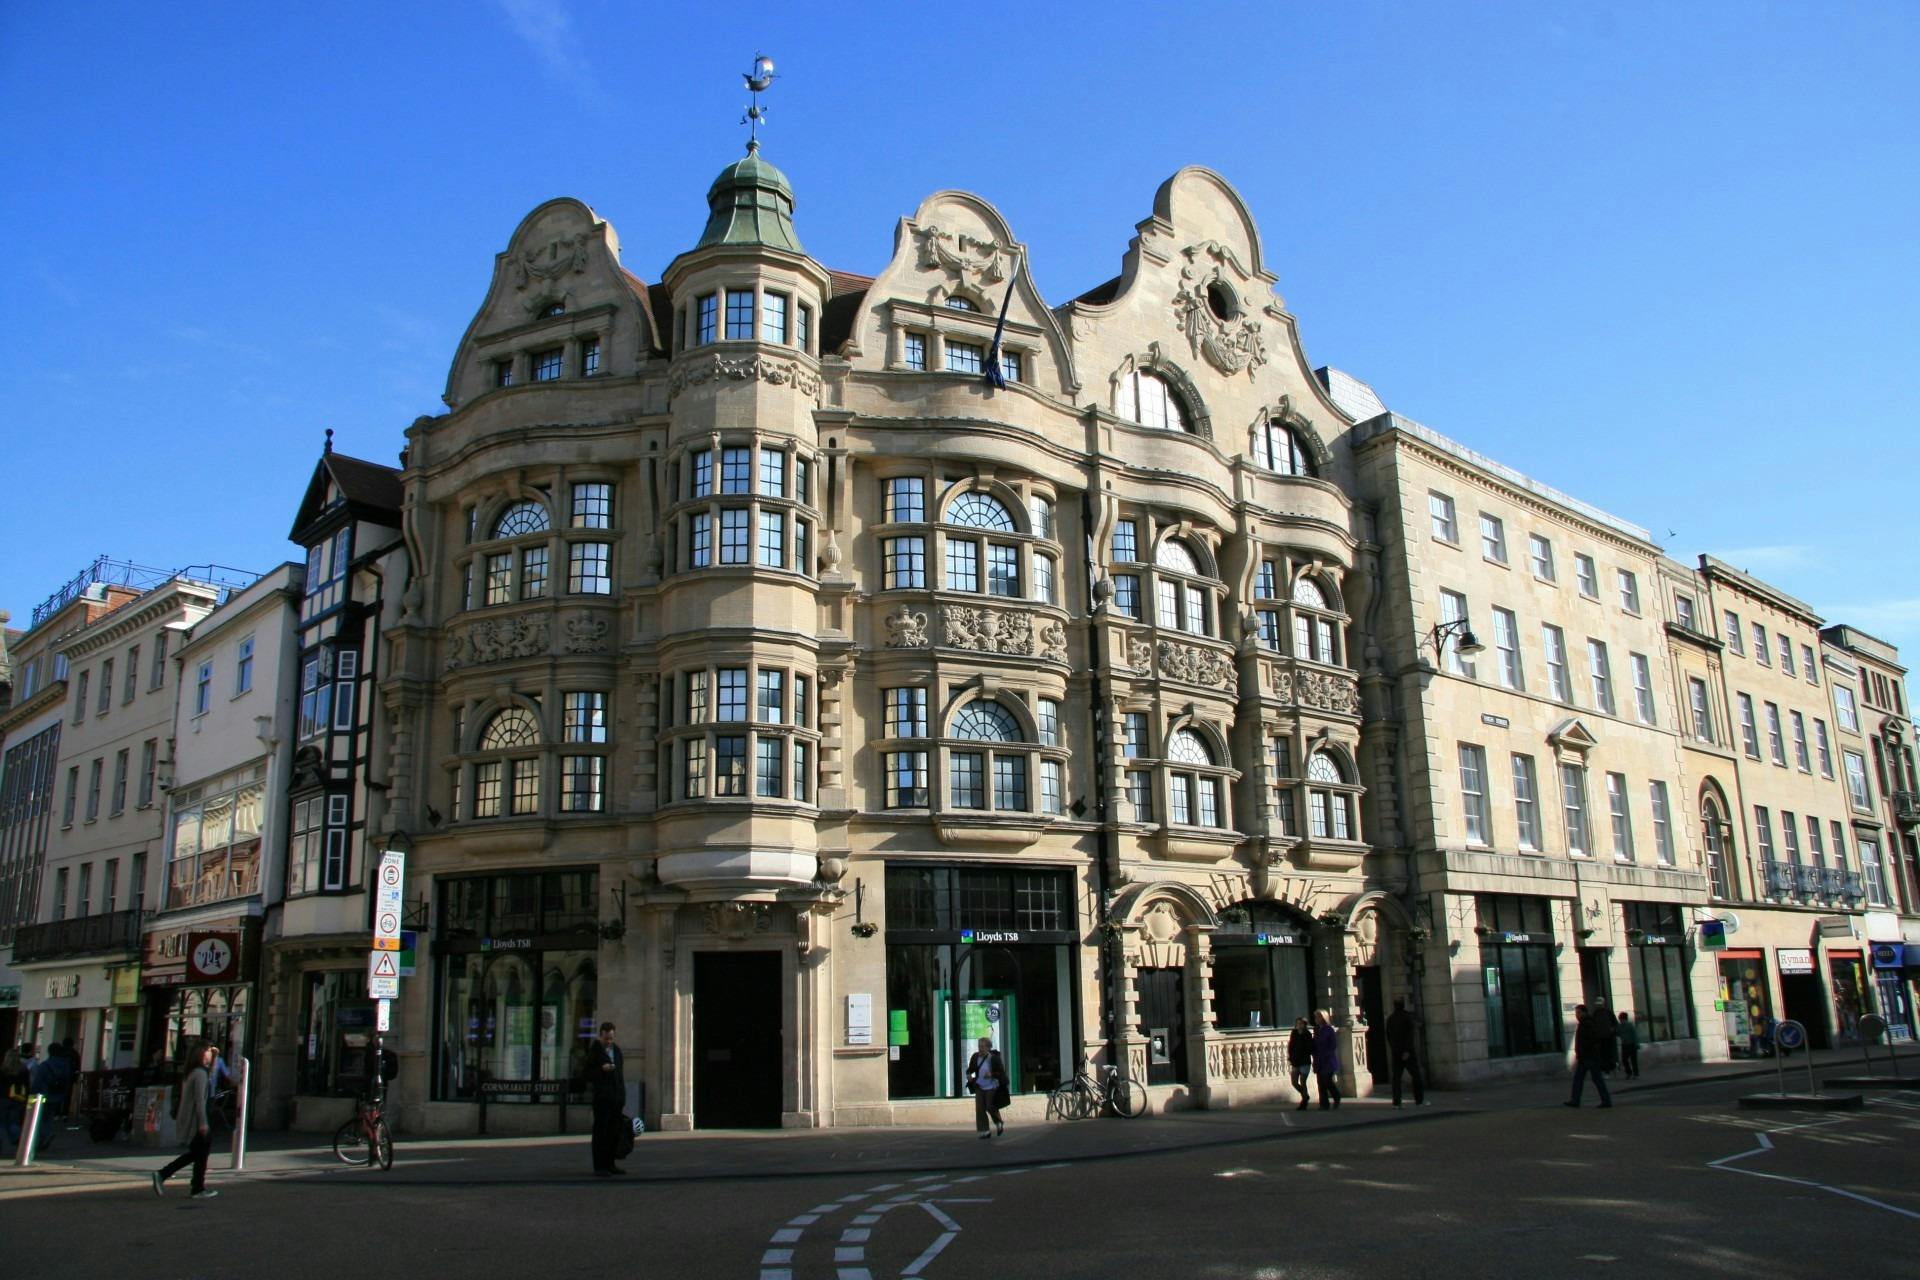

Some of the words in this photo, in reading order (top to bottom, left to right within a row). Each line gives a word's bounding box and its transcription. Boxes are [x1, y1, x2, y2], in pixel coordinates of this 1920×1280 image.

[976, 931, 1002, 943] Lloyds
[1003, 932, 1019, 941] TSB
[1267, 935, 1284, 946] Lloyds
[1284, 935, 1292, 944] TSB
[493, 938, 516, 950] Lloyds
[517, 938, 531, 948] TSB
[1780, 953, 1812, 966] Ryman
[481, 1082, 532, 1092] CORNMARKET
[534, 1082, 561, 1093] STREET
